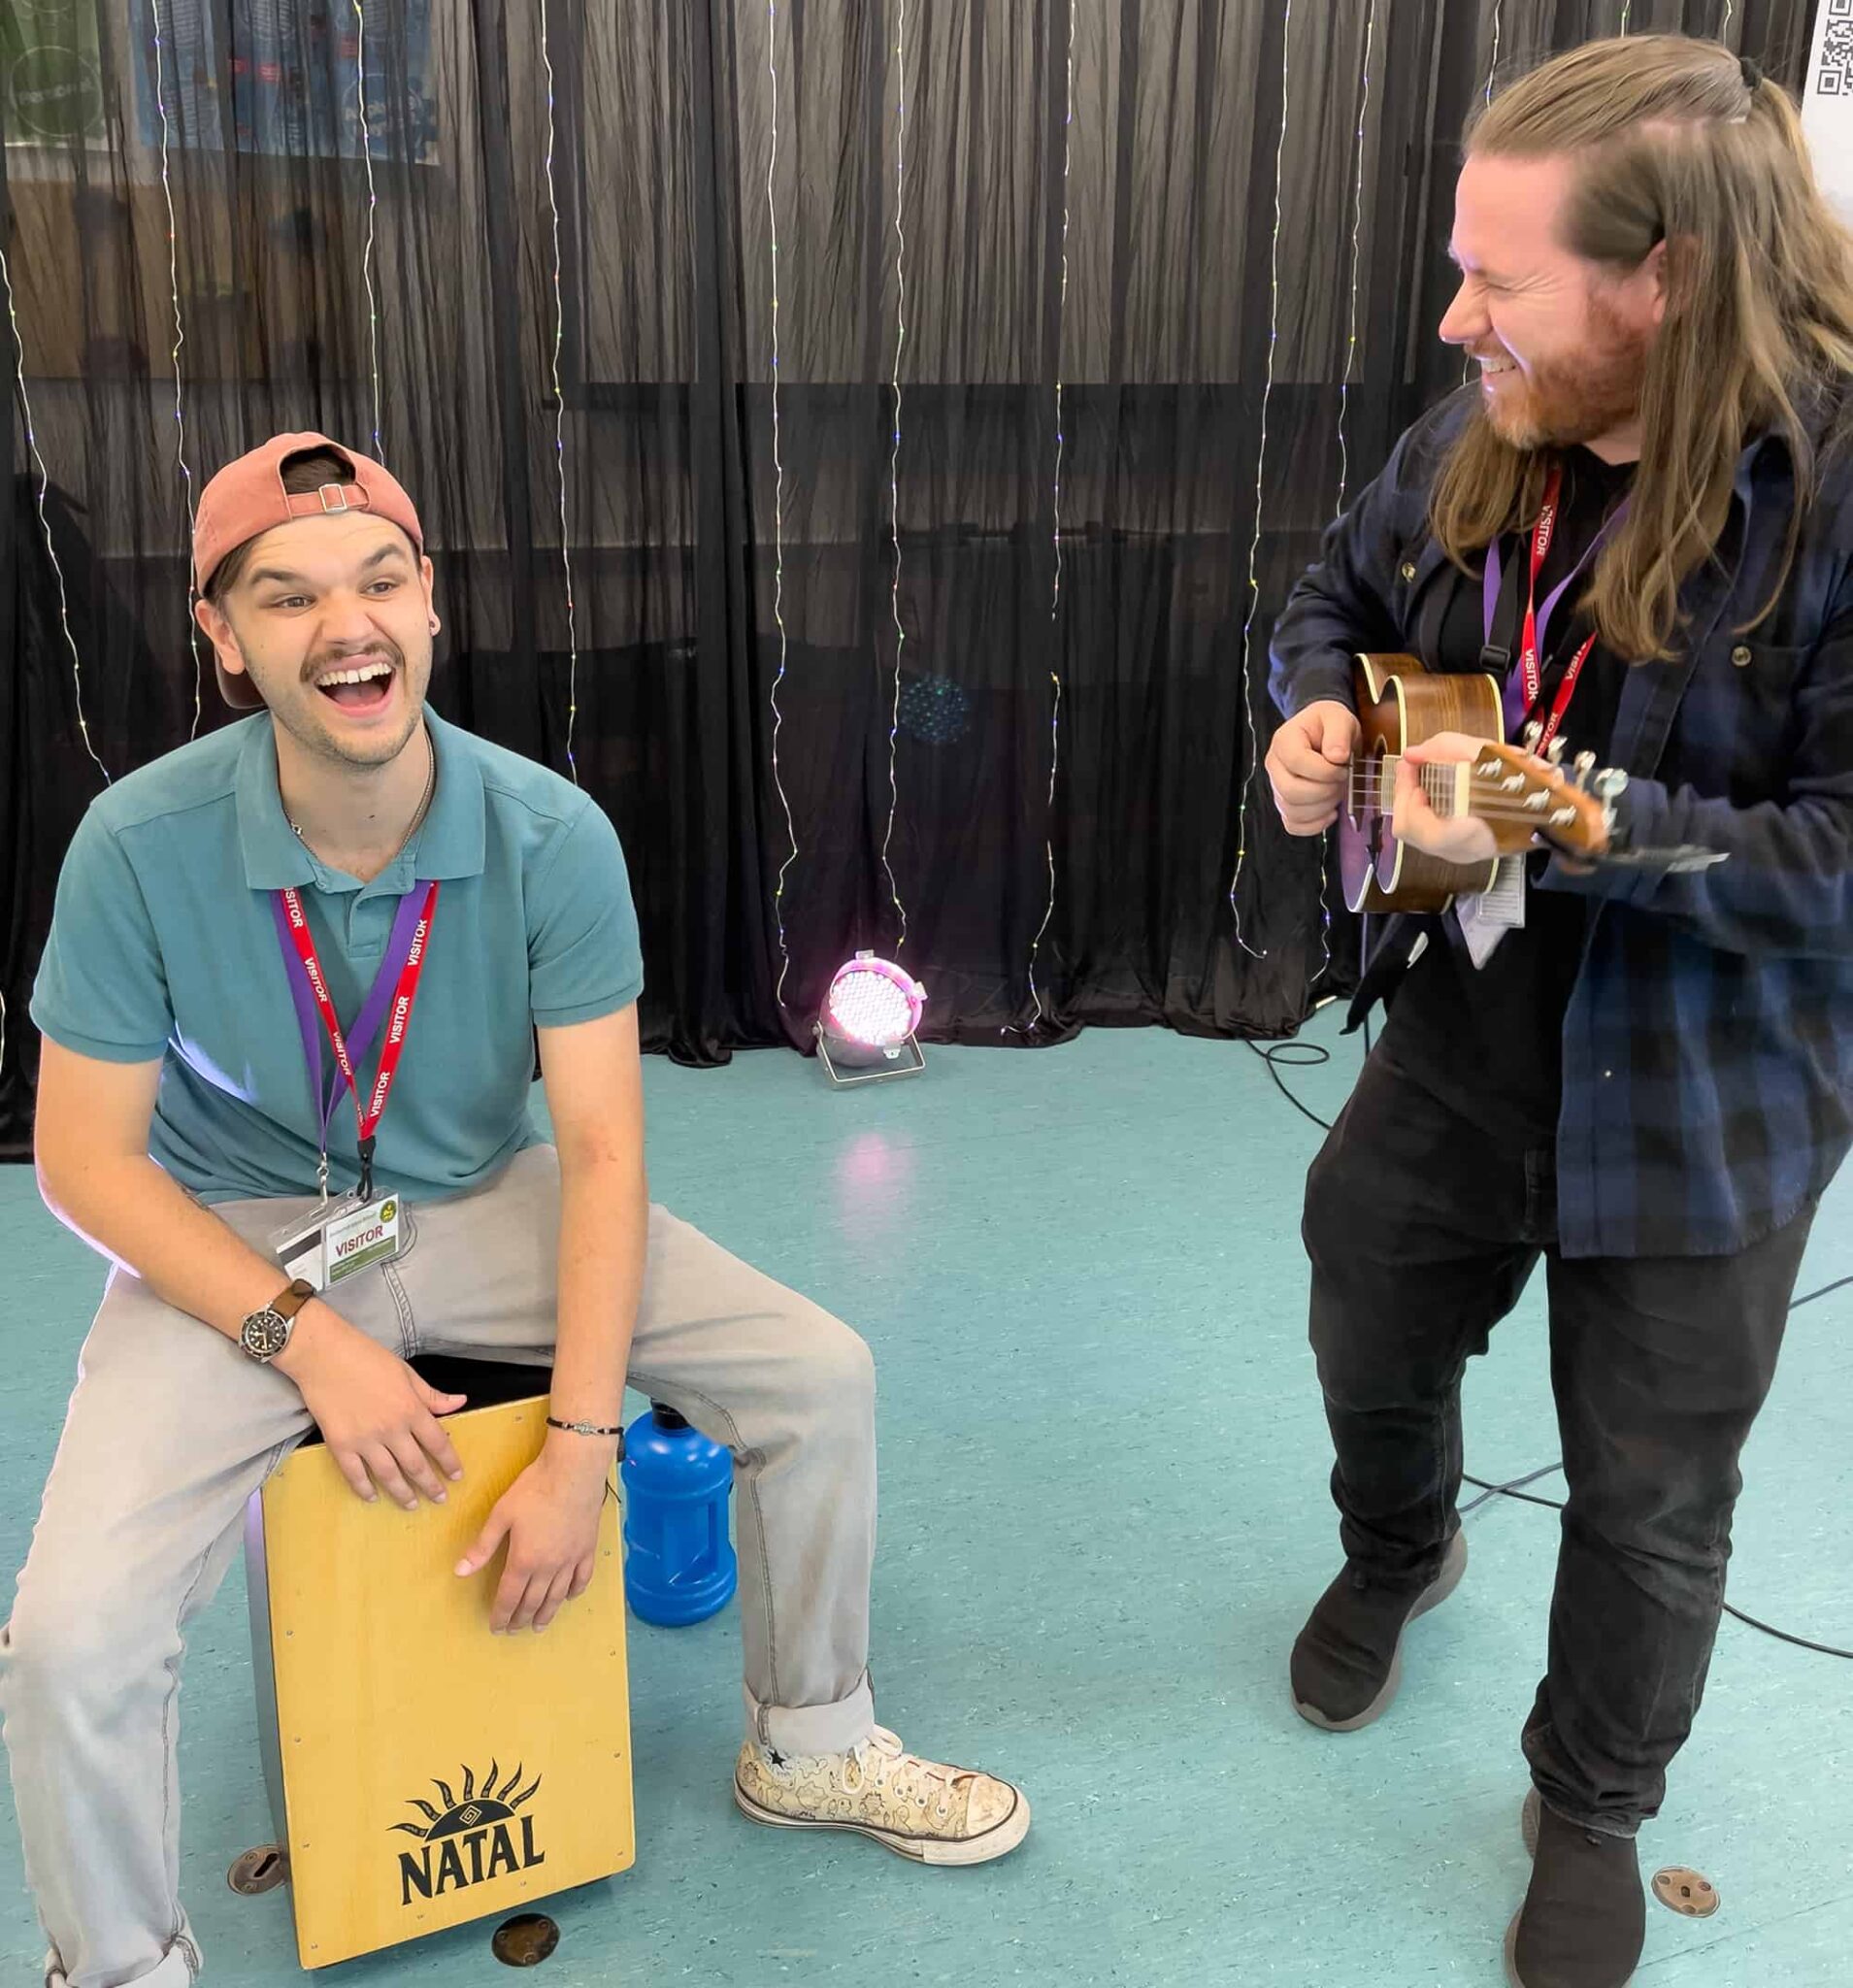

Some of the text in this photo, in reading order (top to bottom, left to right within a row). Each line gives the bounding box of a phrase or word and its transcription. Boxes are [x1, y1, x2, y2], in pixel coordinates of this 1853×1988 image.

[283, 886, 304, 929] ISITOR
[407, 919, 428, 966] VISITOR
[304, 956, 328, 1003] VISITOR
[388, 996, 411, 1044] VISITOR
[370, 1072, 390, 1117] VISITOR
[335, 1225, 383, 1257] VISITOR
[398, 1814, 546, 1905] NATAL
